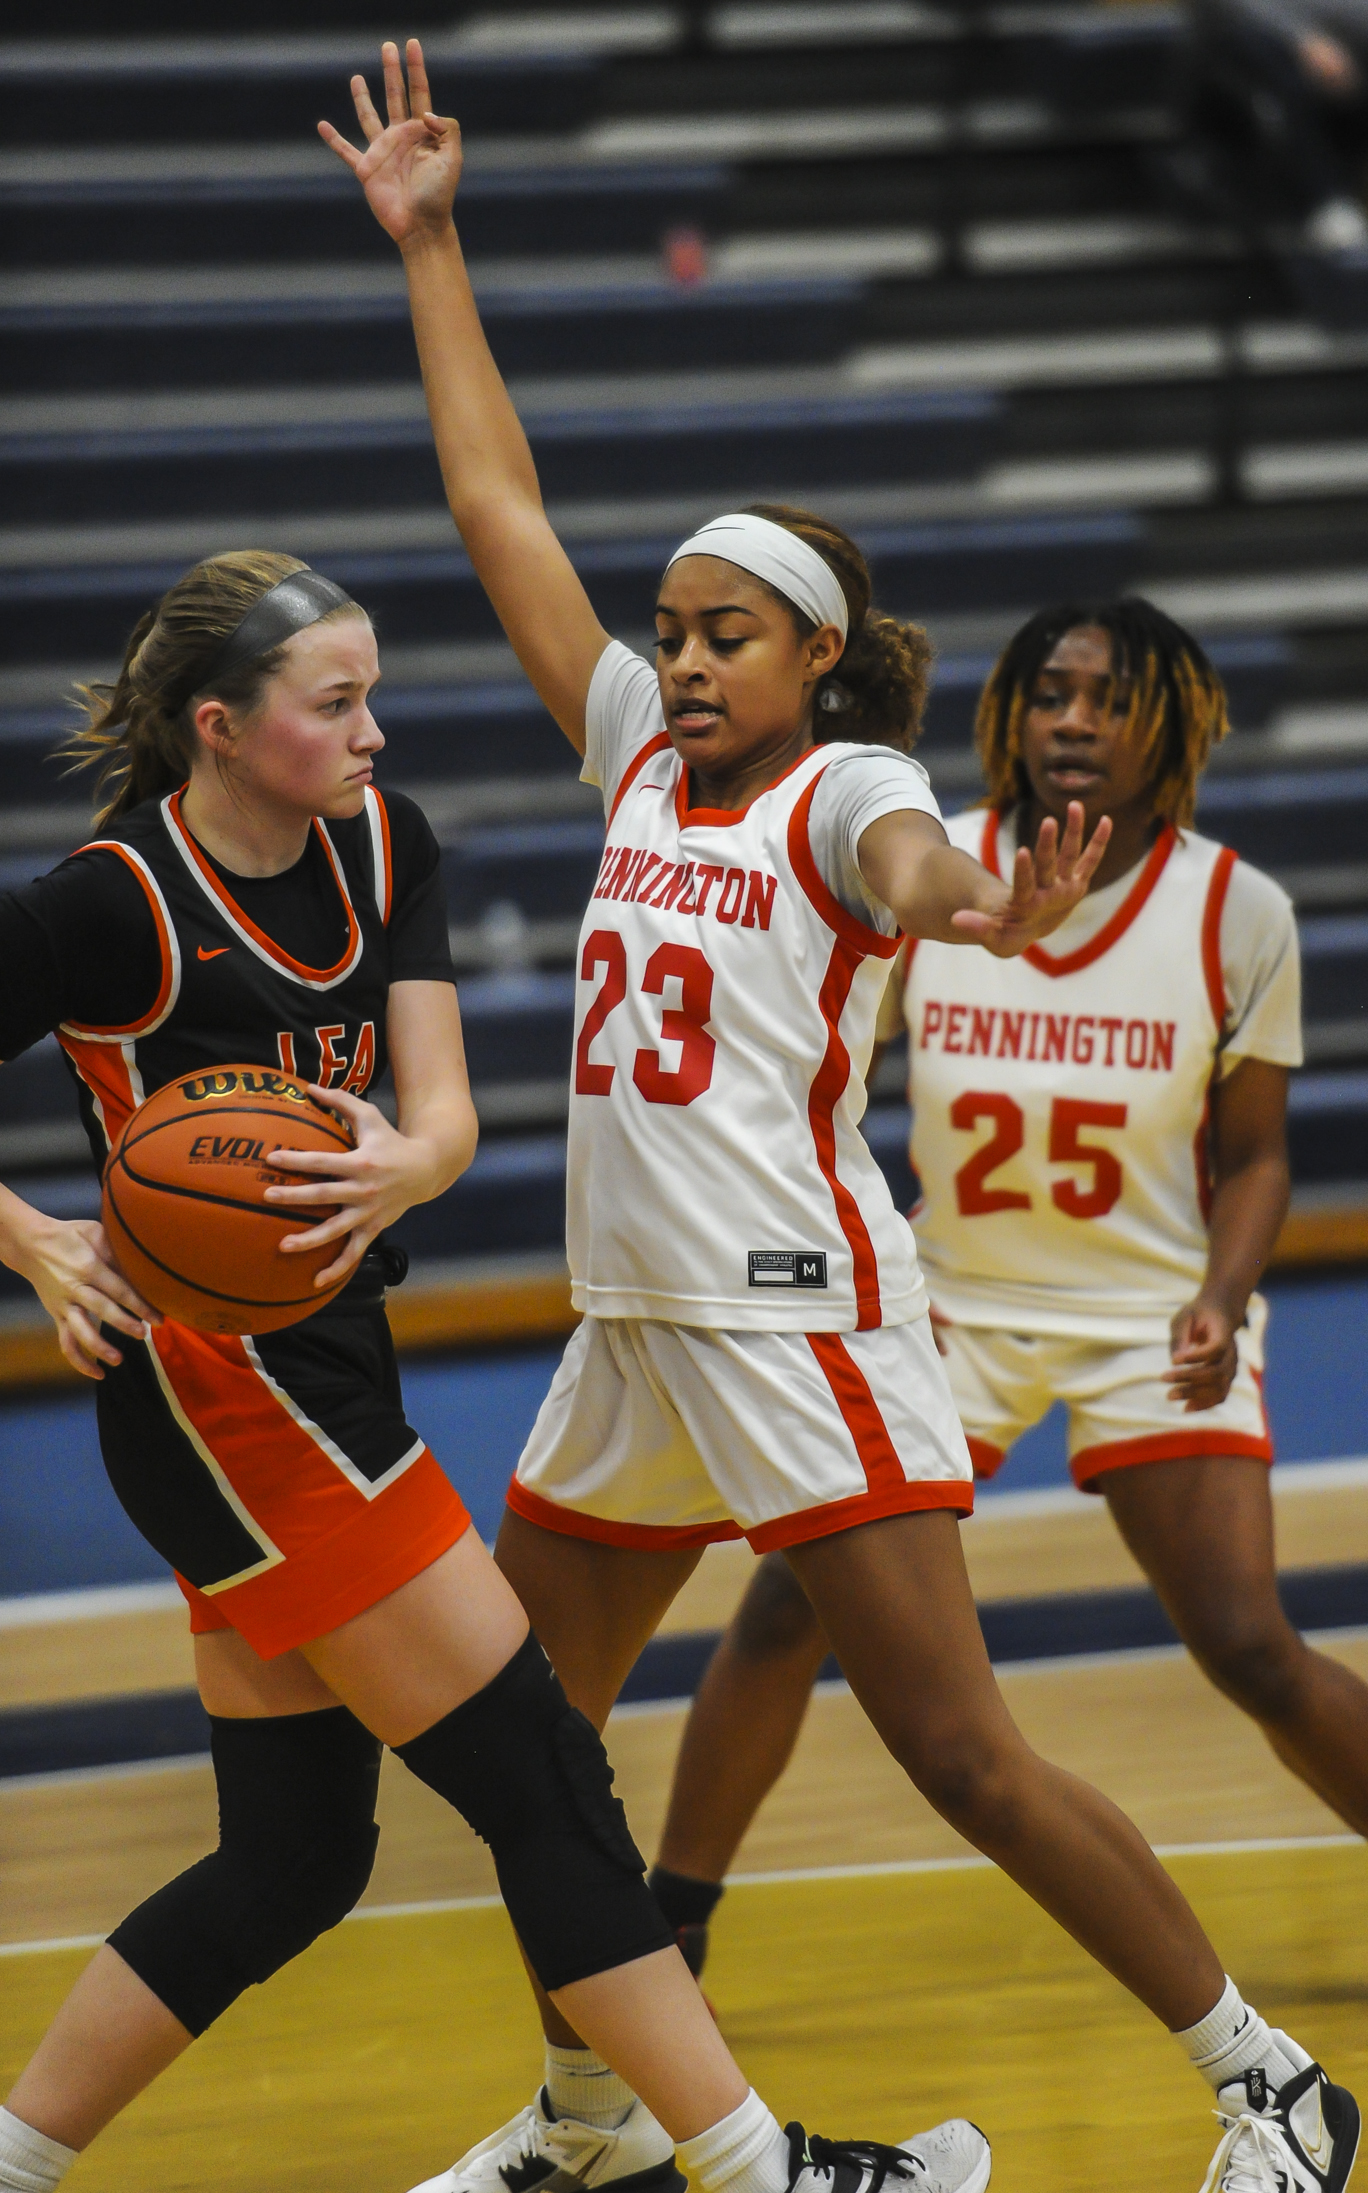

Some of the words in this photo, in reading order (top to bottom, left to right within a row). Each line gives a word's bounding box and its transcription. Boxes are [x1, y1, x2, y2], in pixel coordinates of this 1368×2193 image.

[576, 929, 716, 1107] 23
[920, 1000, 1176, 1072] PENNINGTON
[950, 1090, 1128, 1220] 25
[803, 1262, 817, 1277] M
